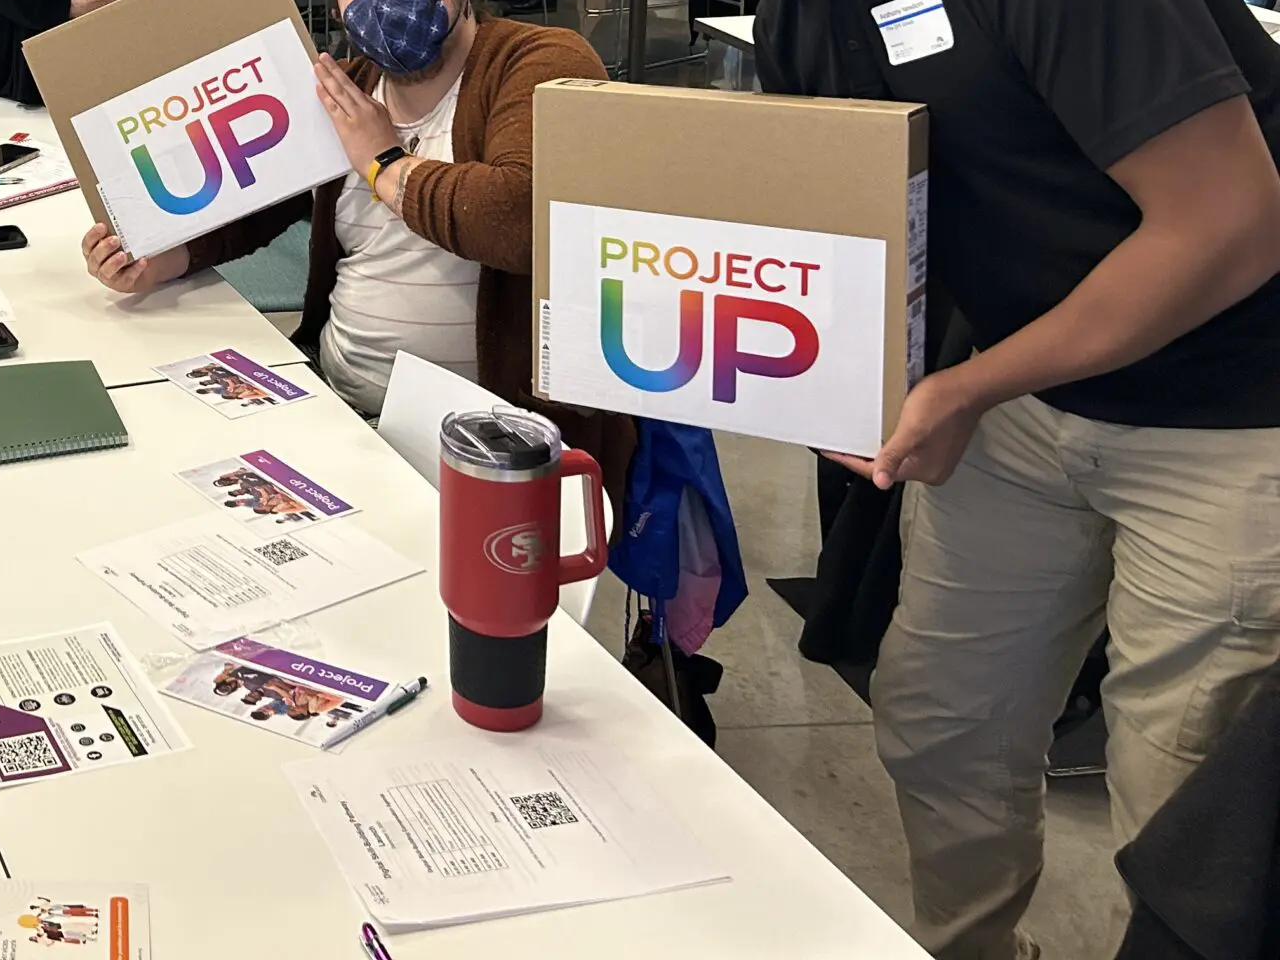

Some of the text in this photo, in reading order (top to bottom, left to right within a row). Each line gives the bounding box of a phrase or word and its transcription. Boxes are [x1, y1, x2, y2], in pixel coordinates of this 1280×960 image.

[117, 56, 263, 142] PROJECT
[131, 93, 290, 216] UP
[600, 236, 821, 297] PROJECT
[600, 278, 820, 404] UP
[252, 370, 298, 397] Project UP
[289, 478, 340, 511] Project UP
[291, 661, 375, 694] Project UP
[340, 800, 392, 880] Digital Skill-Building Pathway
[369, 826, 386, 847] Launch
